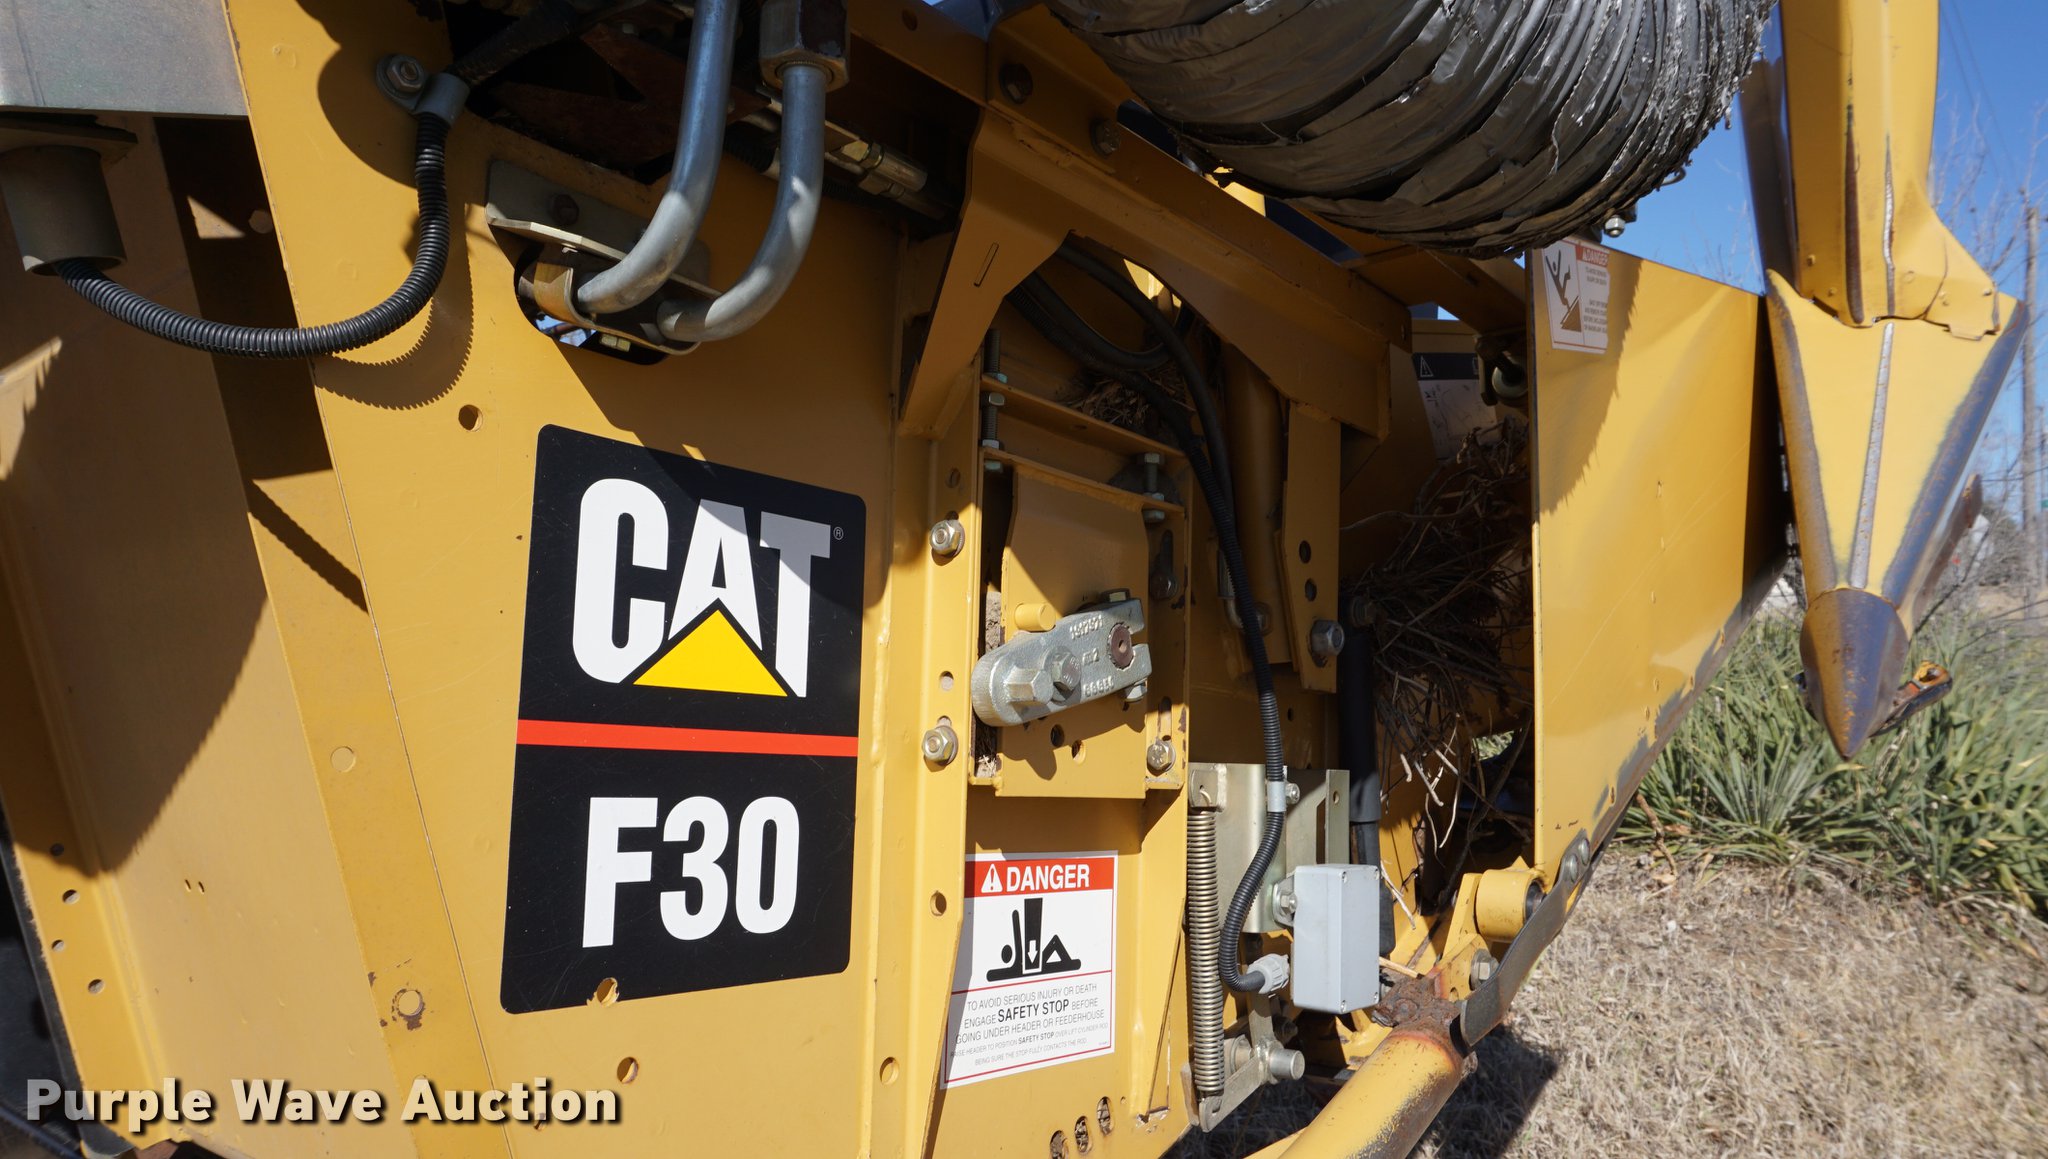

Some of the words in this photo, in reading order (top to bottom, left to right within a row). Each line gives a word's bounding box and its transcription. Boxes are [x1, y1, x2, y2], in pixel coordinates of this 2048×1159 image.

[573, 478, 832, 698] CAT
[582, 796, 800, 948] F30
[1006, 863, 1090, 892] DANGER
[964, 1014, 997, 1029] ENGAGE
[998, 1003, 1040, 1023] SAFETY
[1042, 998, 1070, 1015] STOP
[1072, 997, 1099, 1011] BEFORE
[967, 1000, 978, 1012] TO
[980, 997, 1002, 1010] AVOID
[1004, 992, 1036, 1006] SERIOUS
[1037, 988, 1062, 1000] INJURY
[1063, 986, 1074, 997] OR
[1075, 983, 1097, 995] DEATH
[956, 1030, 982, 1045] GOING
[983, 1025, 1010, 1040] UNDER
[1011, 1020, 1042, 1034] HEADER
[1043, 1018, 1054, 1029] OR
[1055, 1009, 1105, 1026] FEEDERHOUSE
[1018, 1034, 1039, 1045] SAFETY
[1040, 1031, 1055, 1041] STOP
